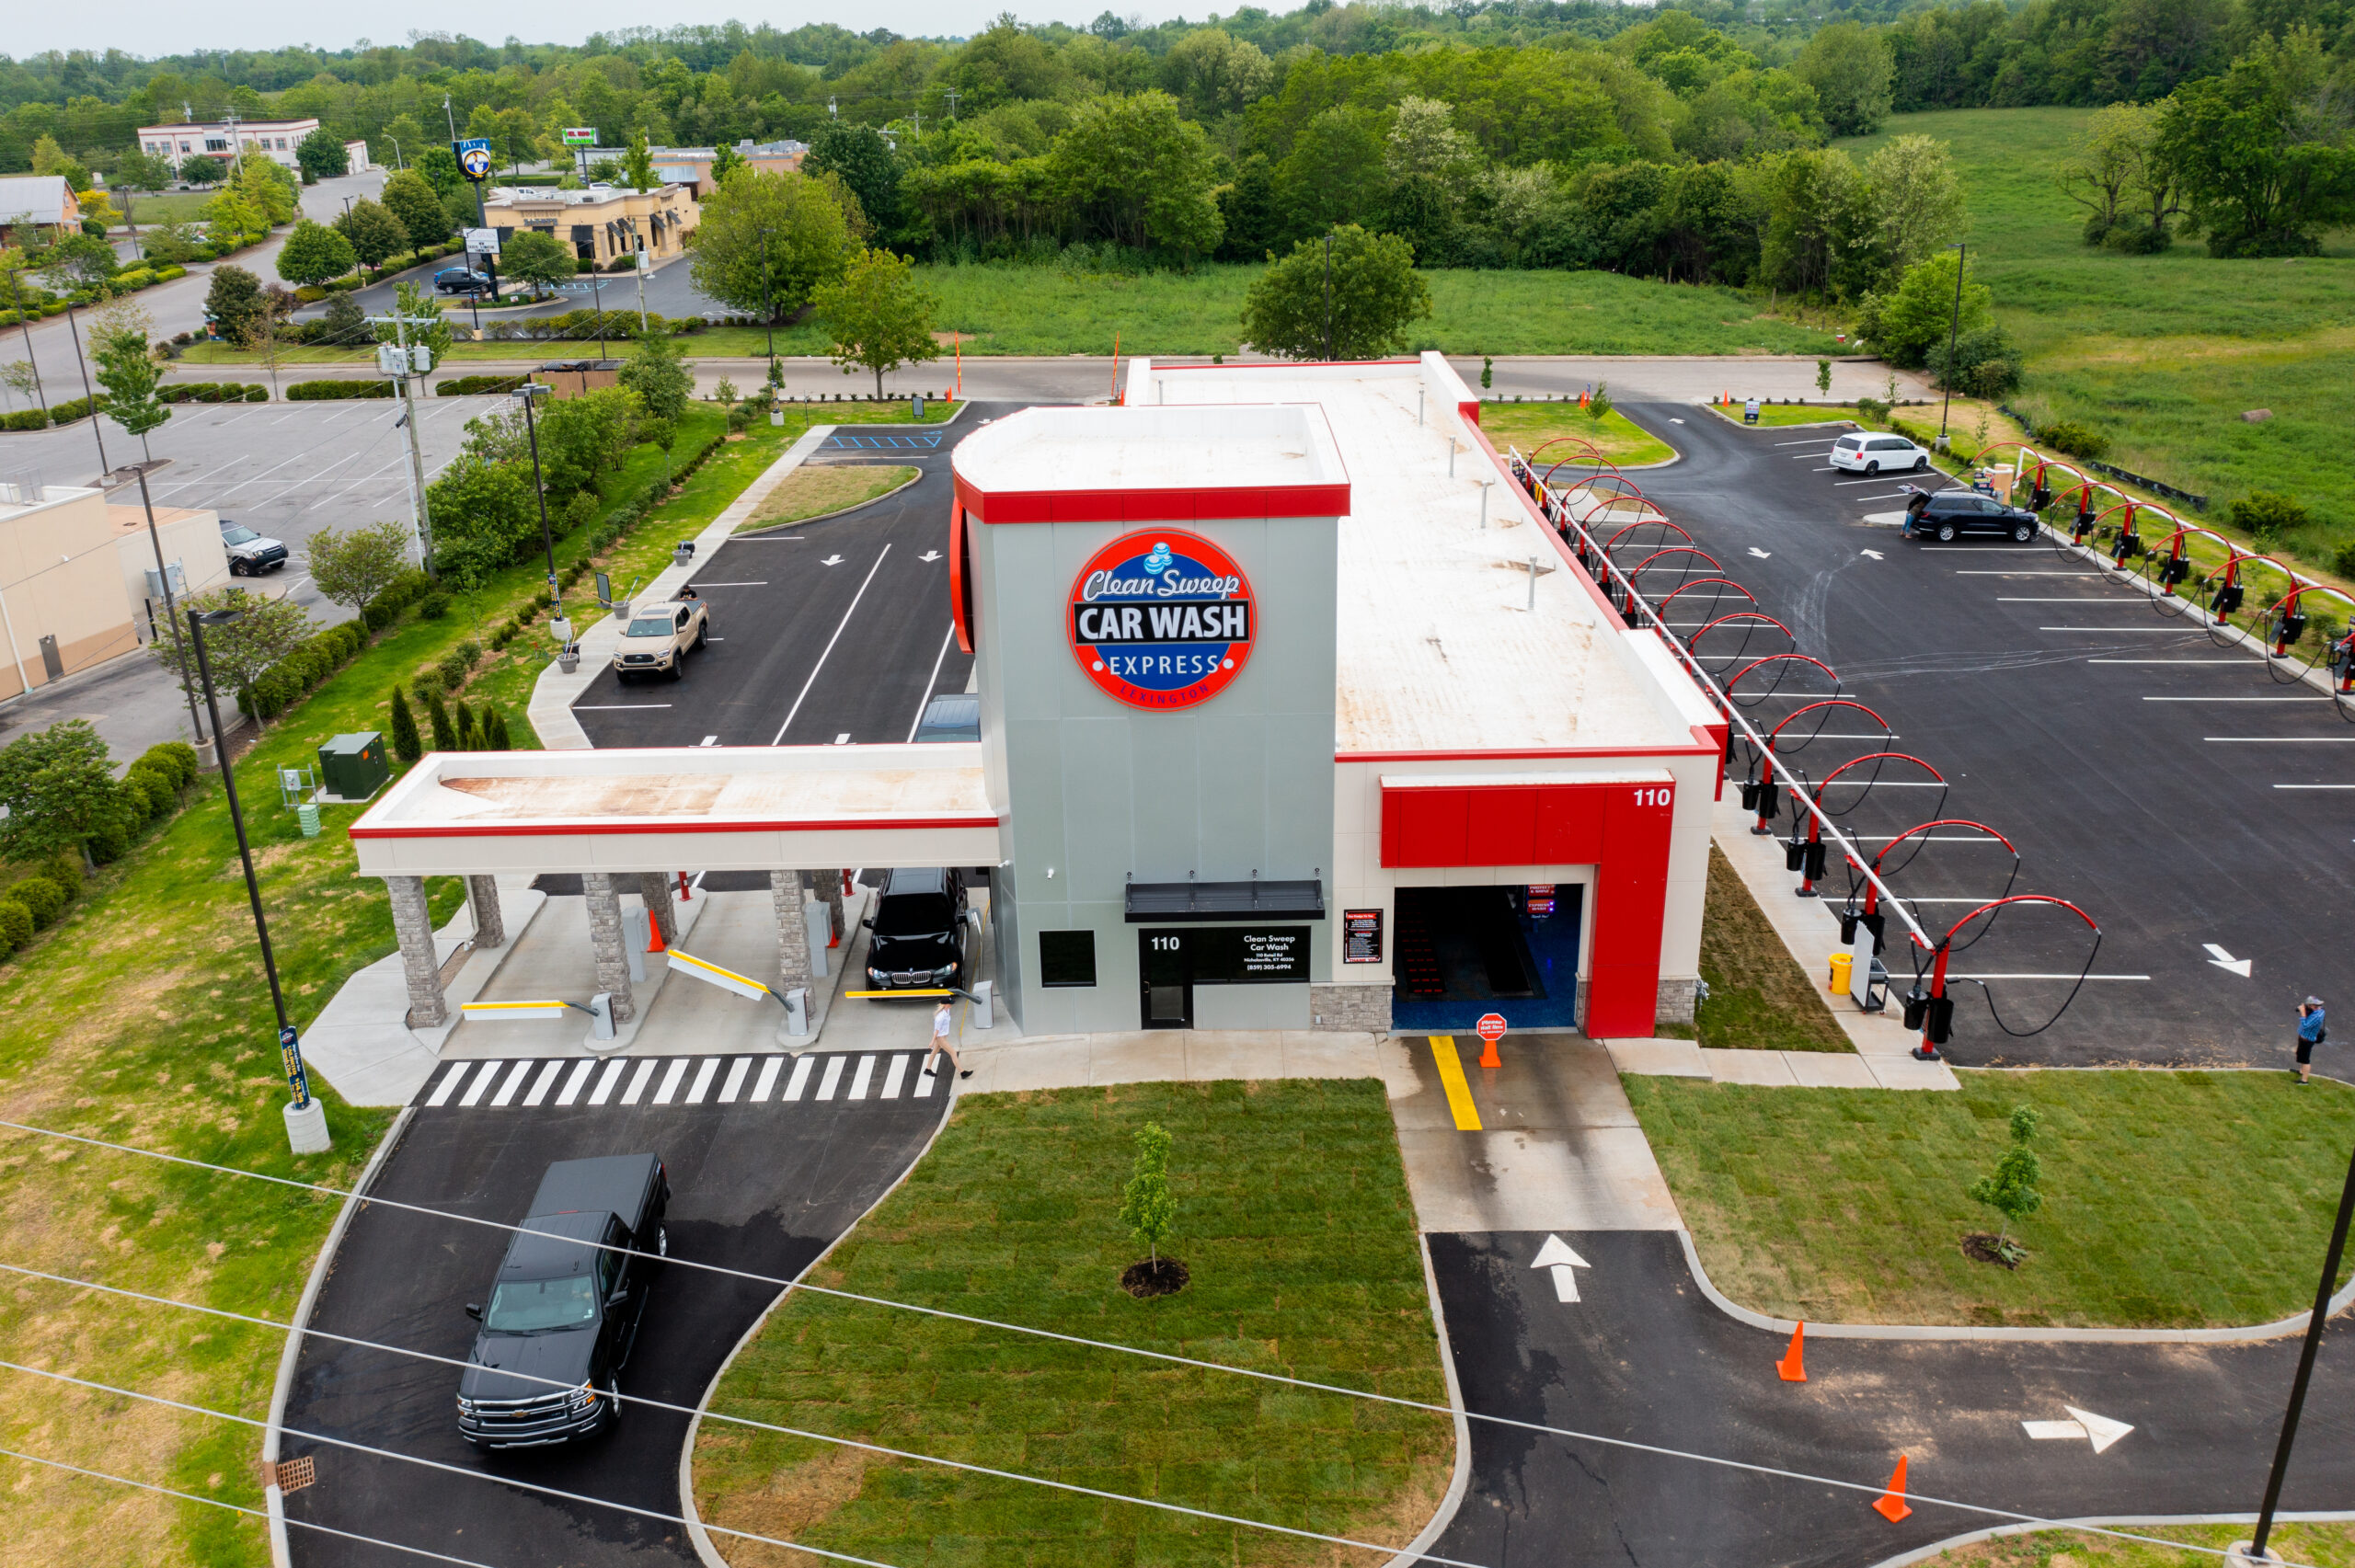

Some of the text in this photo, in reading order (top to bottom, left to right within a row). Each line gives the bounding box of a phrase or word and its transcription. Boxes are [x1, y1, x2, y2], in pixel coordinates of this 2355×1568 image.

[1083, 569, 1240, 602] Clean Sweep
[1079, 605, 1246, 640] CAR WASH
[1109, 655, 1219, 675] EXPRESS
[1120, 683, 1209, 704] LEXINGTON
[1634, 788, 1671, 807] 110
[1151, 936, 1180, 950] 110
[1244, 934, 1295, 944] Clean Sweep
